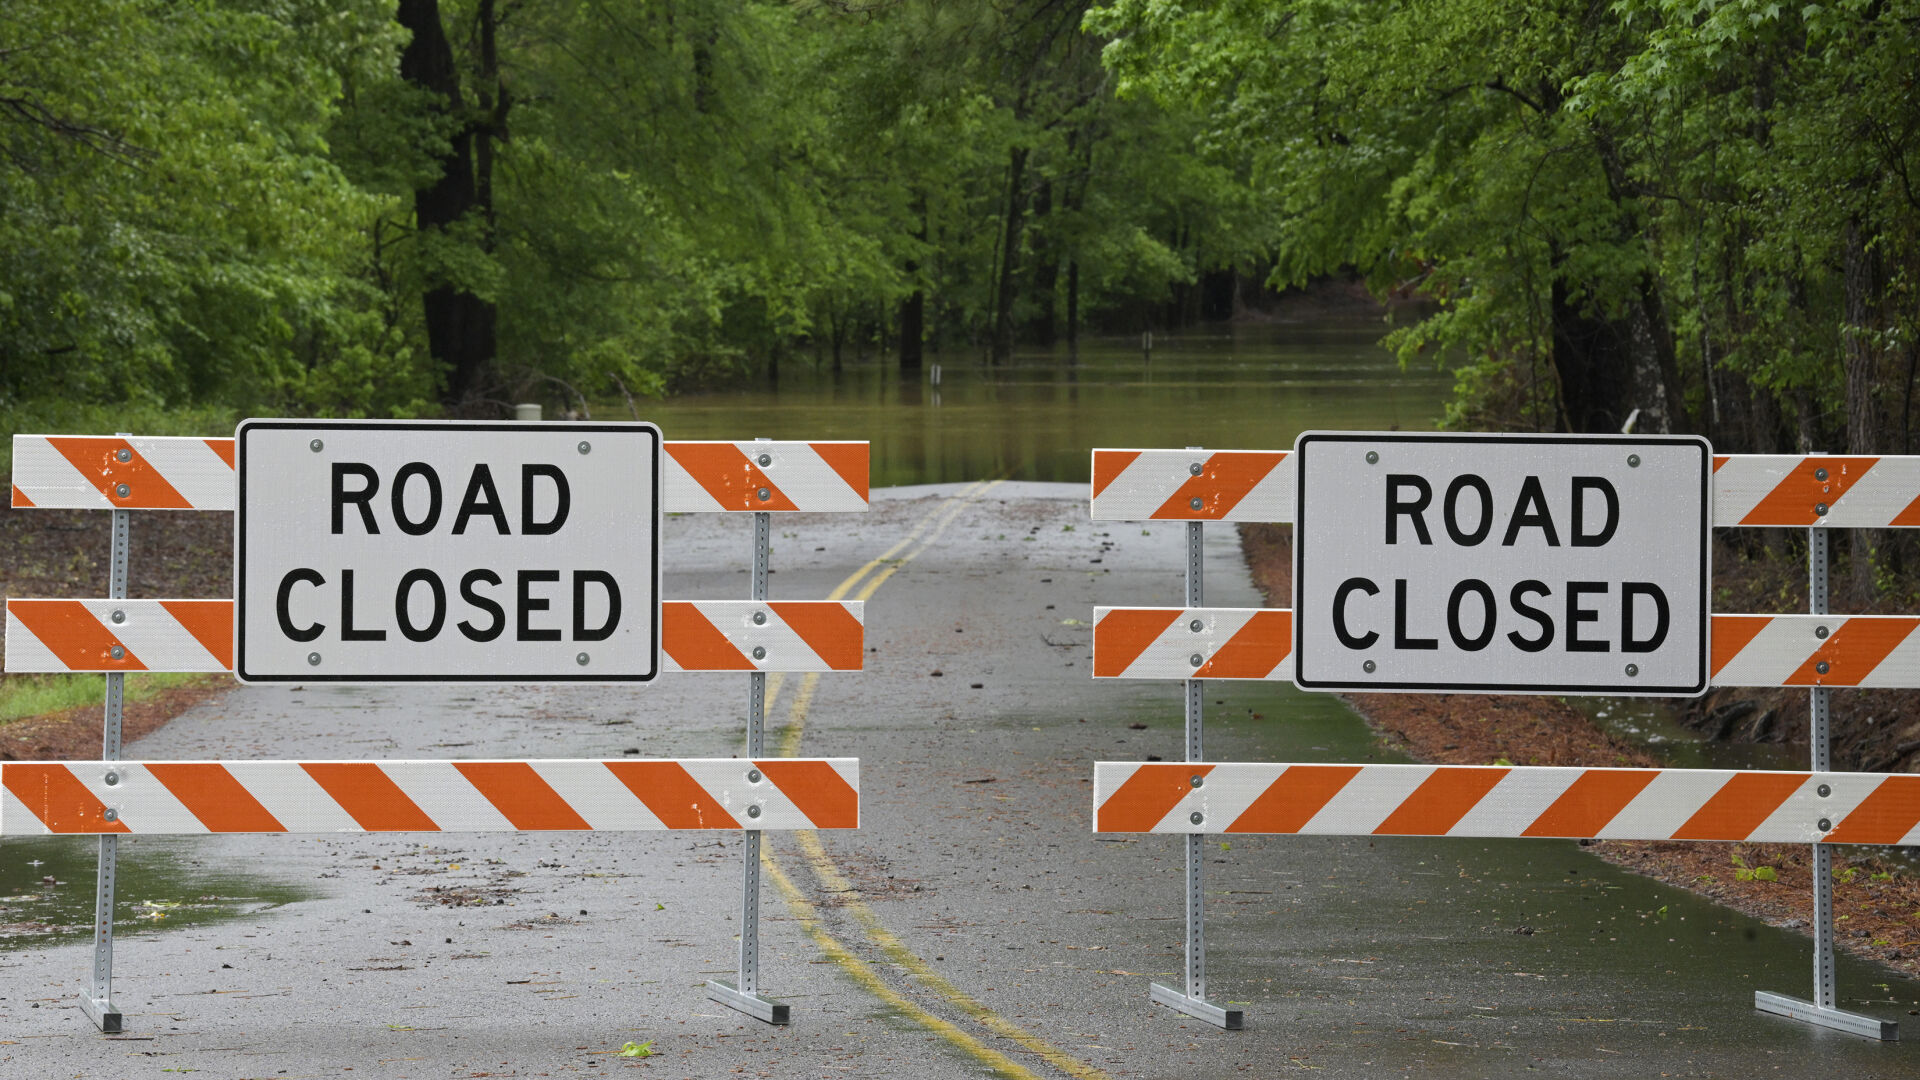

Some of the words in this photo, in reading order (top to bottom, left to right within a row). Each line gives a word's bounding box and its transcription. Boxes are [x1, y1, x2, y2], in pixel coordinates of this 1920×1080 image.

[331, 462, 571, 536] ROAD
[1385, 473, 1620, 548] ROAD
[276, 567, 622, 643] CLOSED
[1332, 576, 1671, 654] CLOSED
